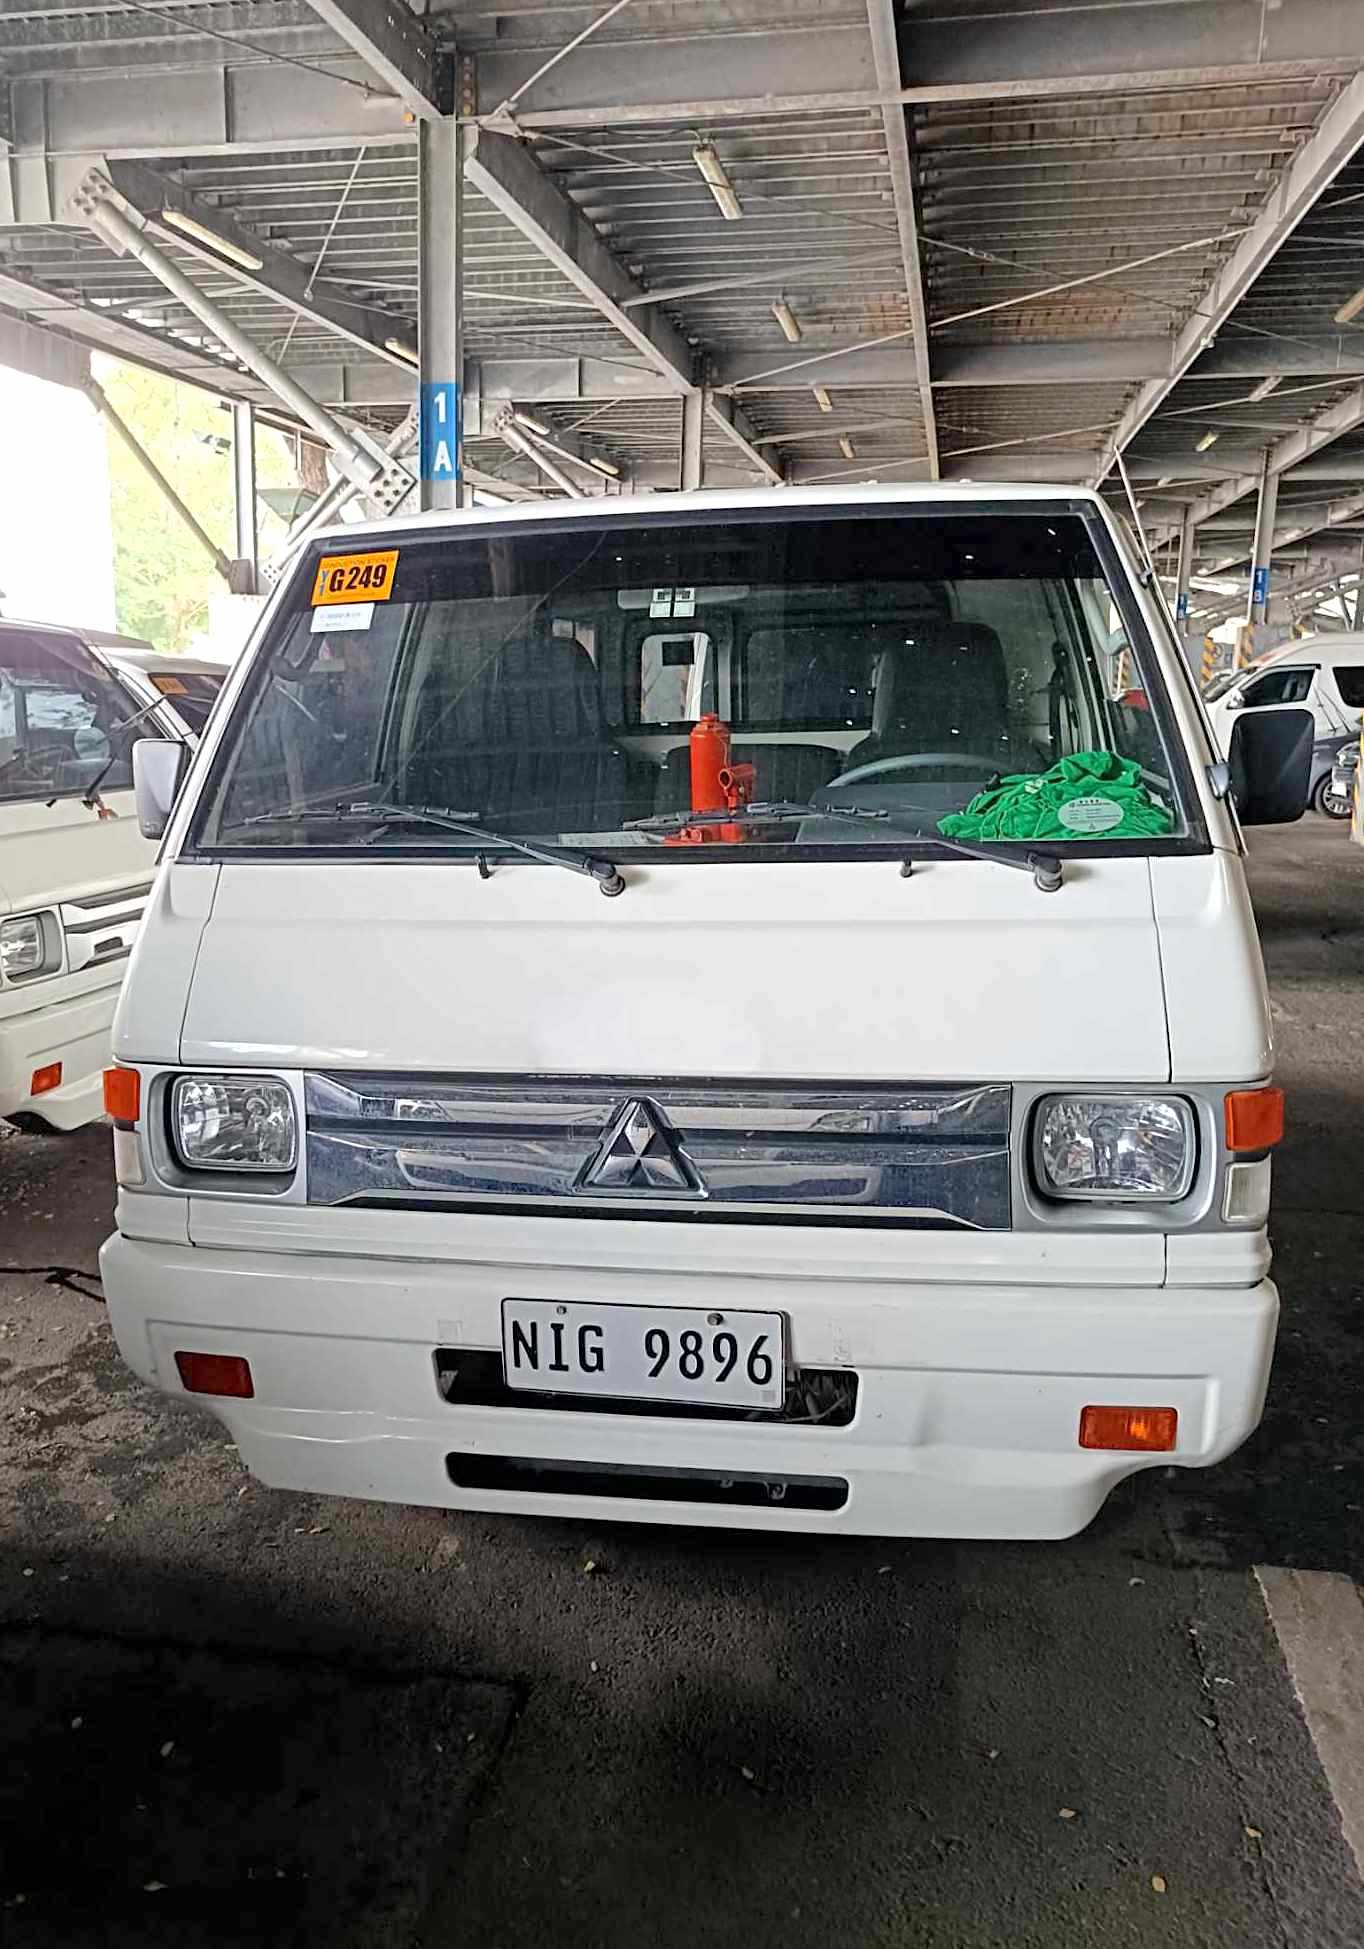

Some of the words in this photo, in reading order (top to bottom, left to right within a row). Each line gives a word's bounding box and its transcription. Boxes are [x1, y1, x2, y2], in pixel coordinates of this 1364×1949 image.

[434, 392, 446, 423] 1
[434, 440, 452, 472] A
[511, 1320, 605, 1373] NIG
[644, 1328, 773, 1385] 9896
